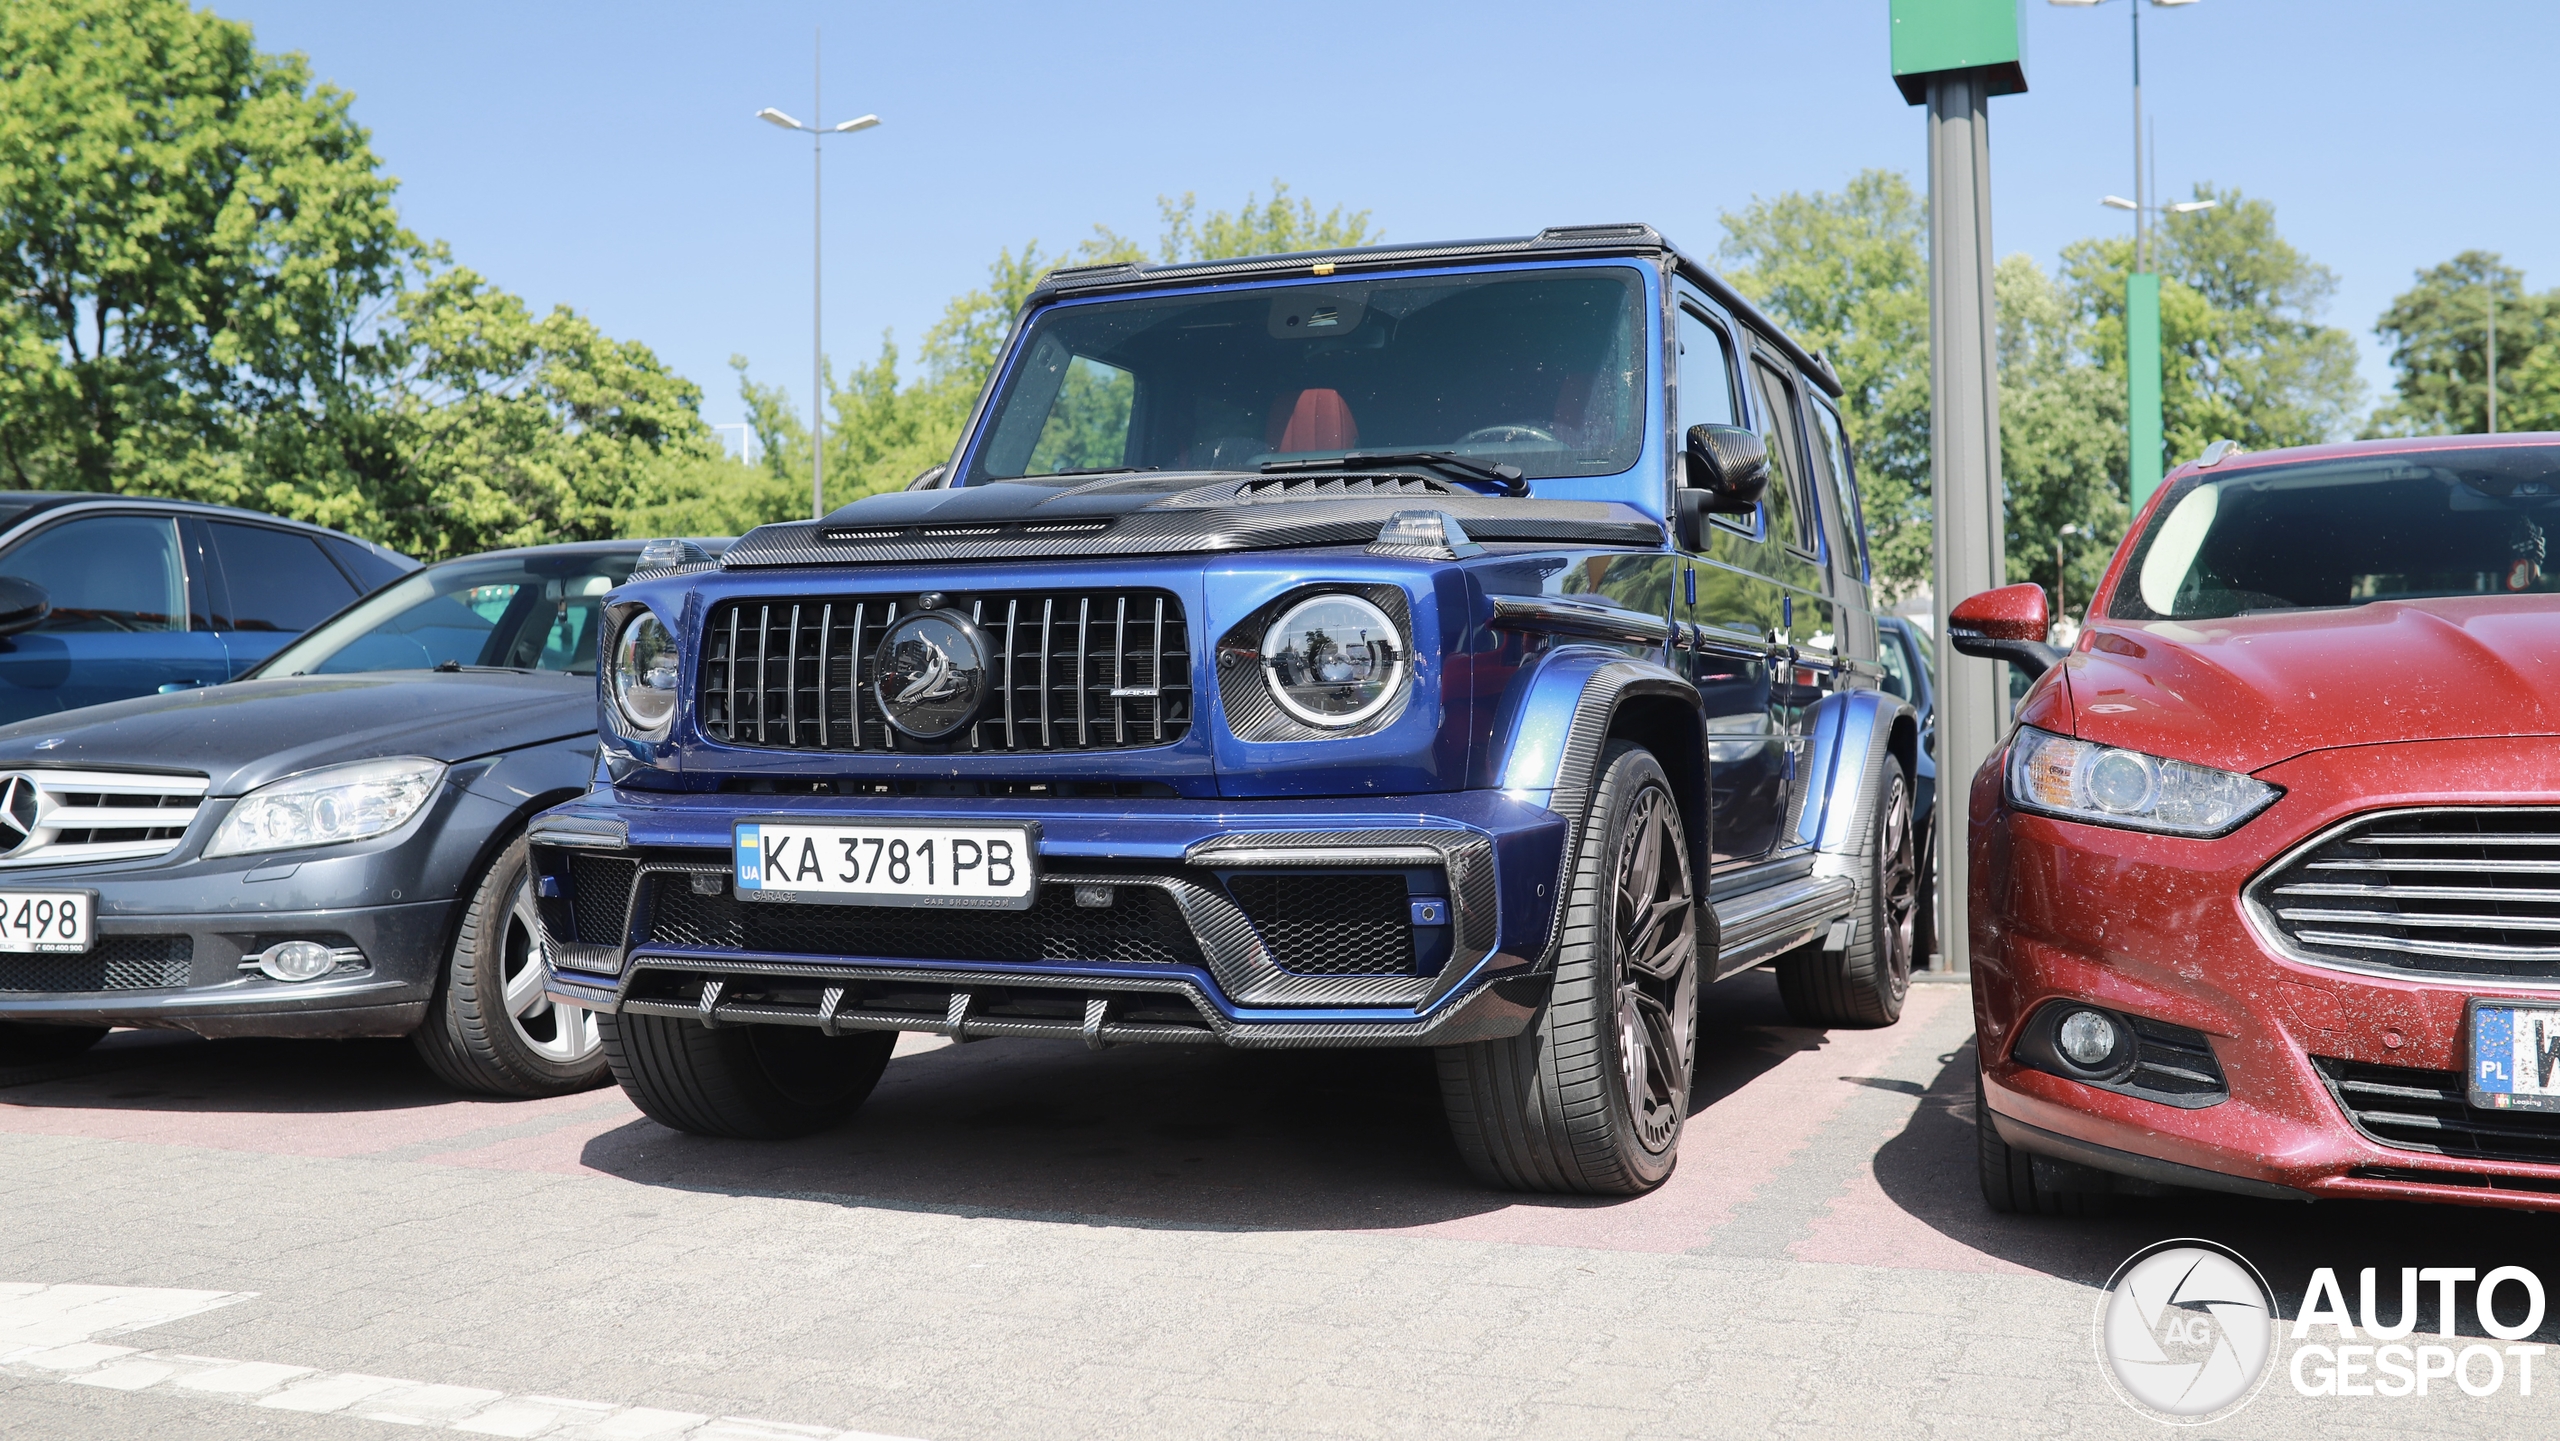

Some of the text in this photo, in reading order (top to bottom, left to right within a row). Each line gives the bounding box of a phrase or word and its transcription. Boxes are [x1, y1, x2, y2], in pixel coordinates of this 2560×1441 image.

[763, 835, 1016, 887] KA 3781 PB
[741, 865, 760, 881] UA
[751, 890, 797, 902] GARAGE
[923, 898, 1010, 908] CAR SHOWROOM
[55, 944, 69, 952] 400
[2480, 1060, 2509, 1081] PL
